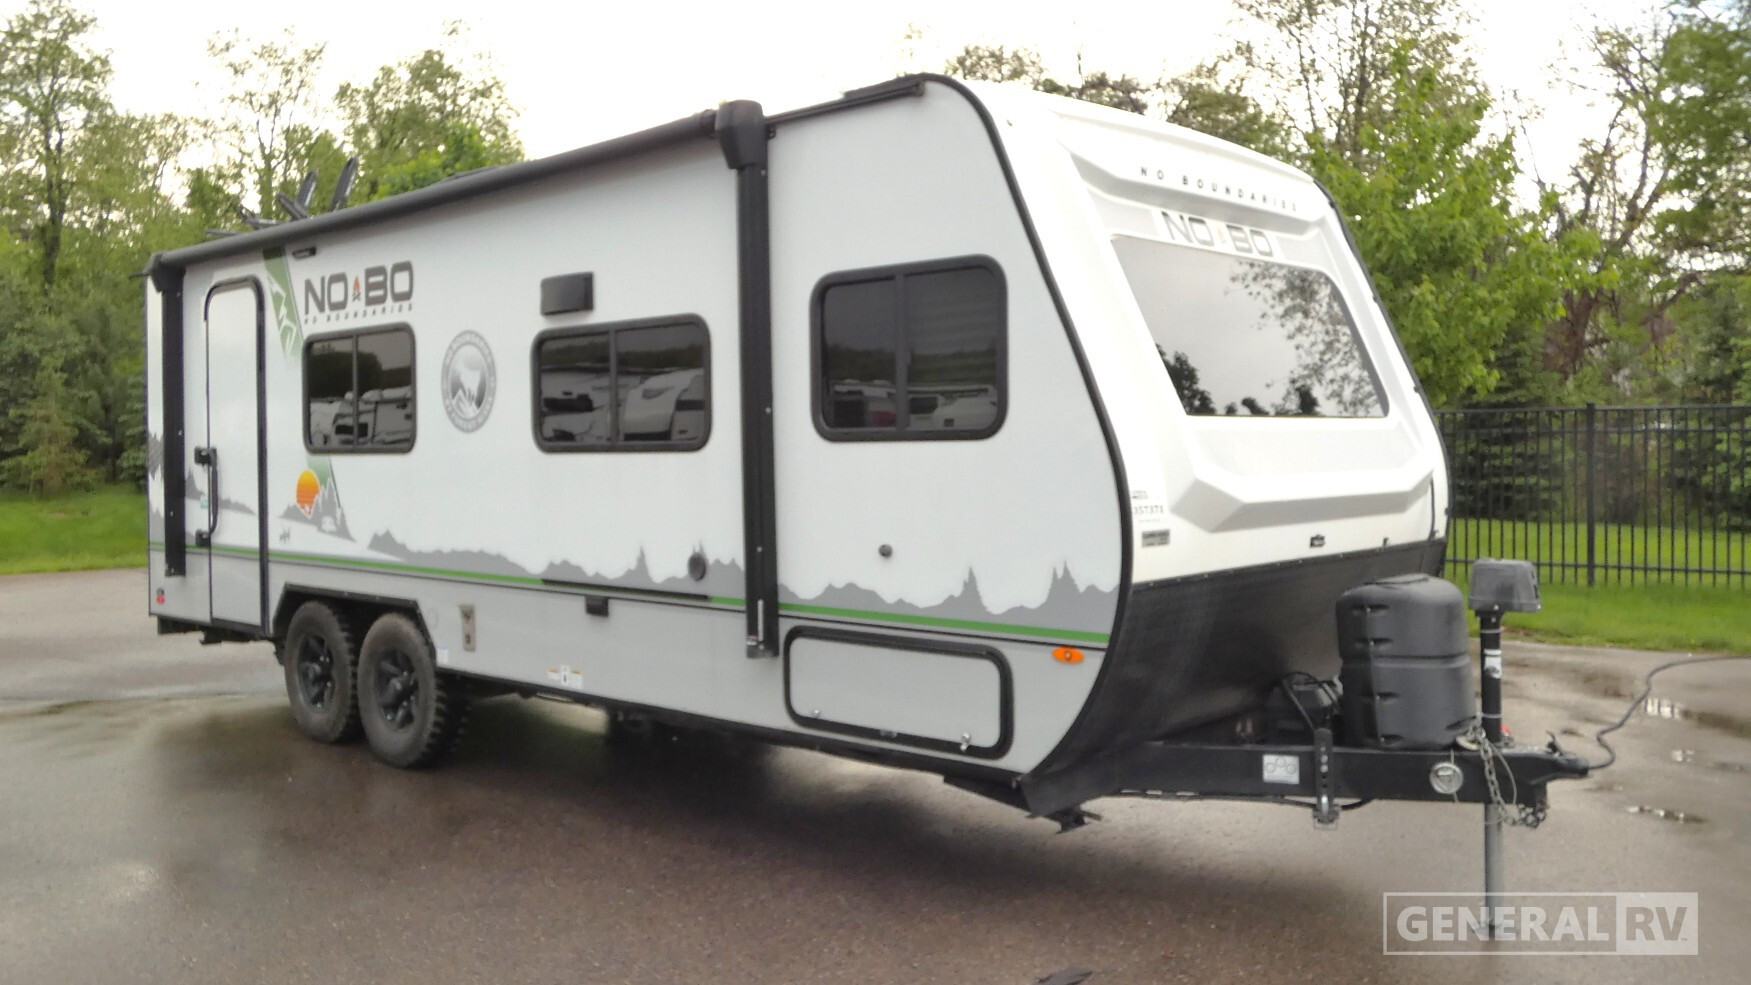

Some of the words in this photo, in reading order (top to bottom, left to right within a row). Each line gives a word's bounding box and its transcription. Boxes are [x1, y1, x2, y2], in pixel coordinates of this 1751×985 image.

[1140, 166, 1164, 181] NO
[1161, 210, 1215, 247] NO
[1226, 224, 1274, 258] BO
[304, 271, 349, 316] NO
[364, 260, 414, 307] BO
